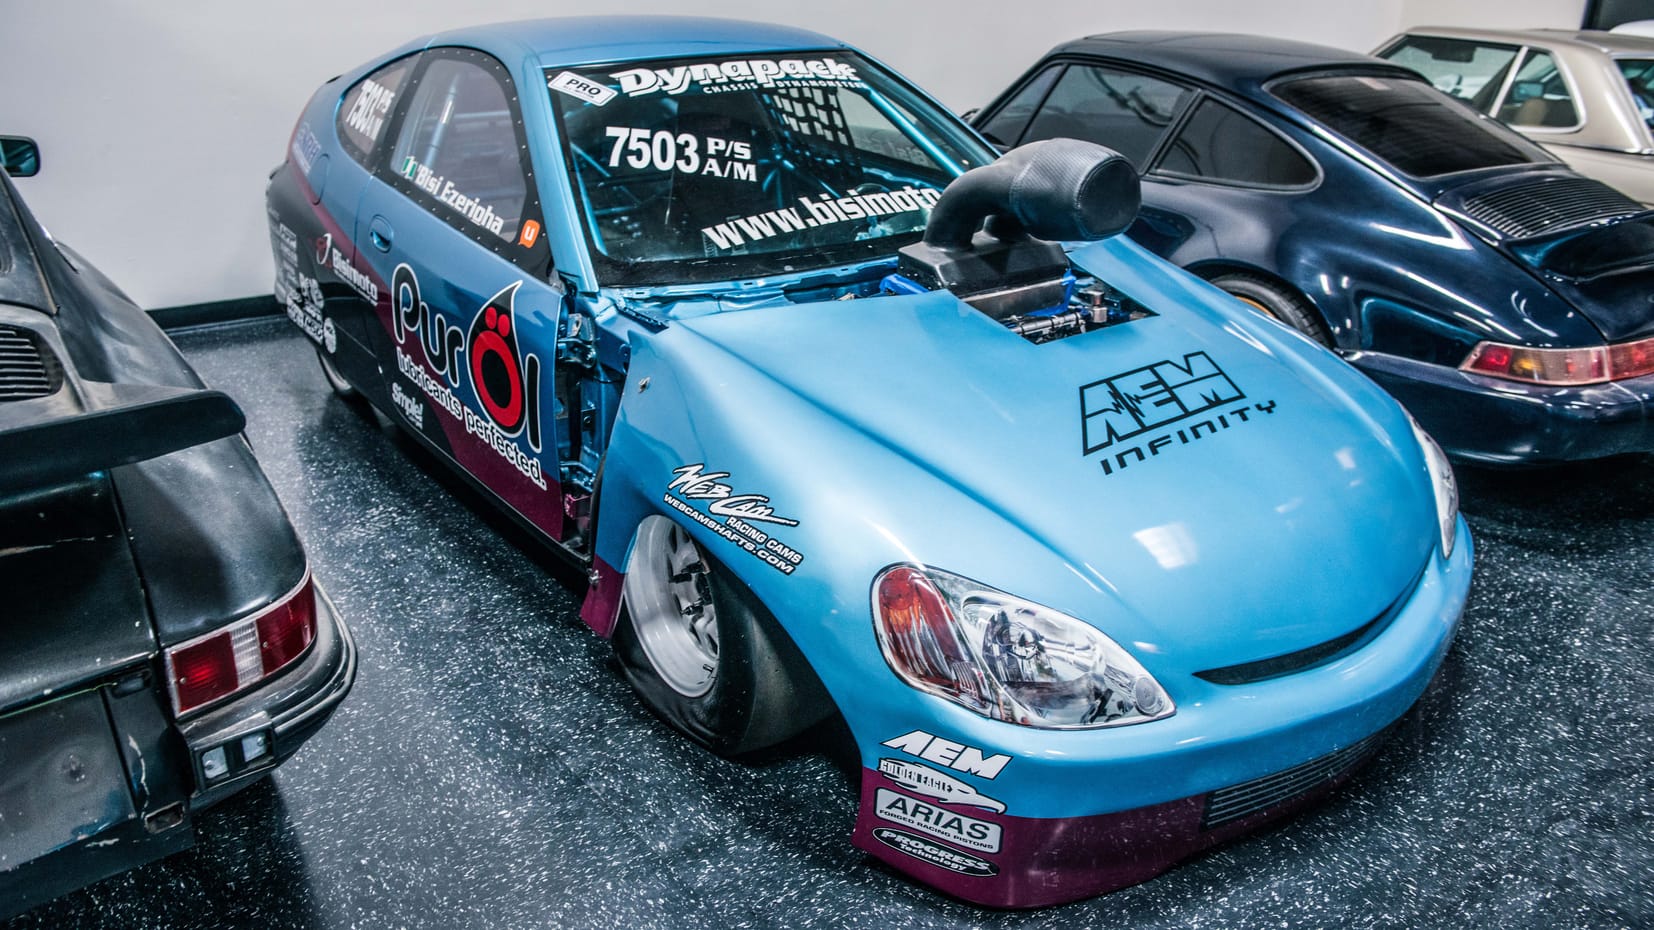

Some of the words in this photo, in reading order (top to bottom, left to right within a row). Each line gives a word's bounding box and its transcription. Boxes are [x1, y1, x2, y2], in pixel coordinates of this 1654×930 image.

[566, 79, 602, 96] PRO
[608, 58, 860, 97] Dynapack
[702, 82, 758, 94] CHASSIS
[606, 126, 699, 173] 7503
[706, 137, 752, 160] P/S
[700, 158, 757, 182] A/M
[391, 382, 423, 420] Simple!
[396, 346, 463, 420] lubricants
[463, 406, 547, 491] perfected.
[1079, 350, 1247, 457] AEM
[1100, 400, 1277, 475] INFINITY
[668, 463, 733, 499] WEB
[663, 492, 797, 575] WEBCAMSHAFTS.COM
[727, 516, 768, 544] RACING
[765, 538, 803, 565] CAMS
[879, 729, 1013, 780] AEM
[880, 810, 915, 824] FORGED
[916, 822, 951, 838] RACING
[953, 834, 994, 850] PISTONS
[886, 797, 991, 840] ARIAS
[880, 830, 990, 870] PROGRESS
[899, 844, 968, 871] Technology
